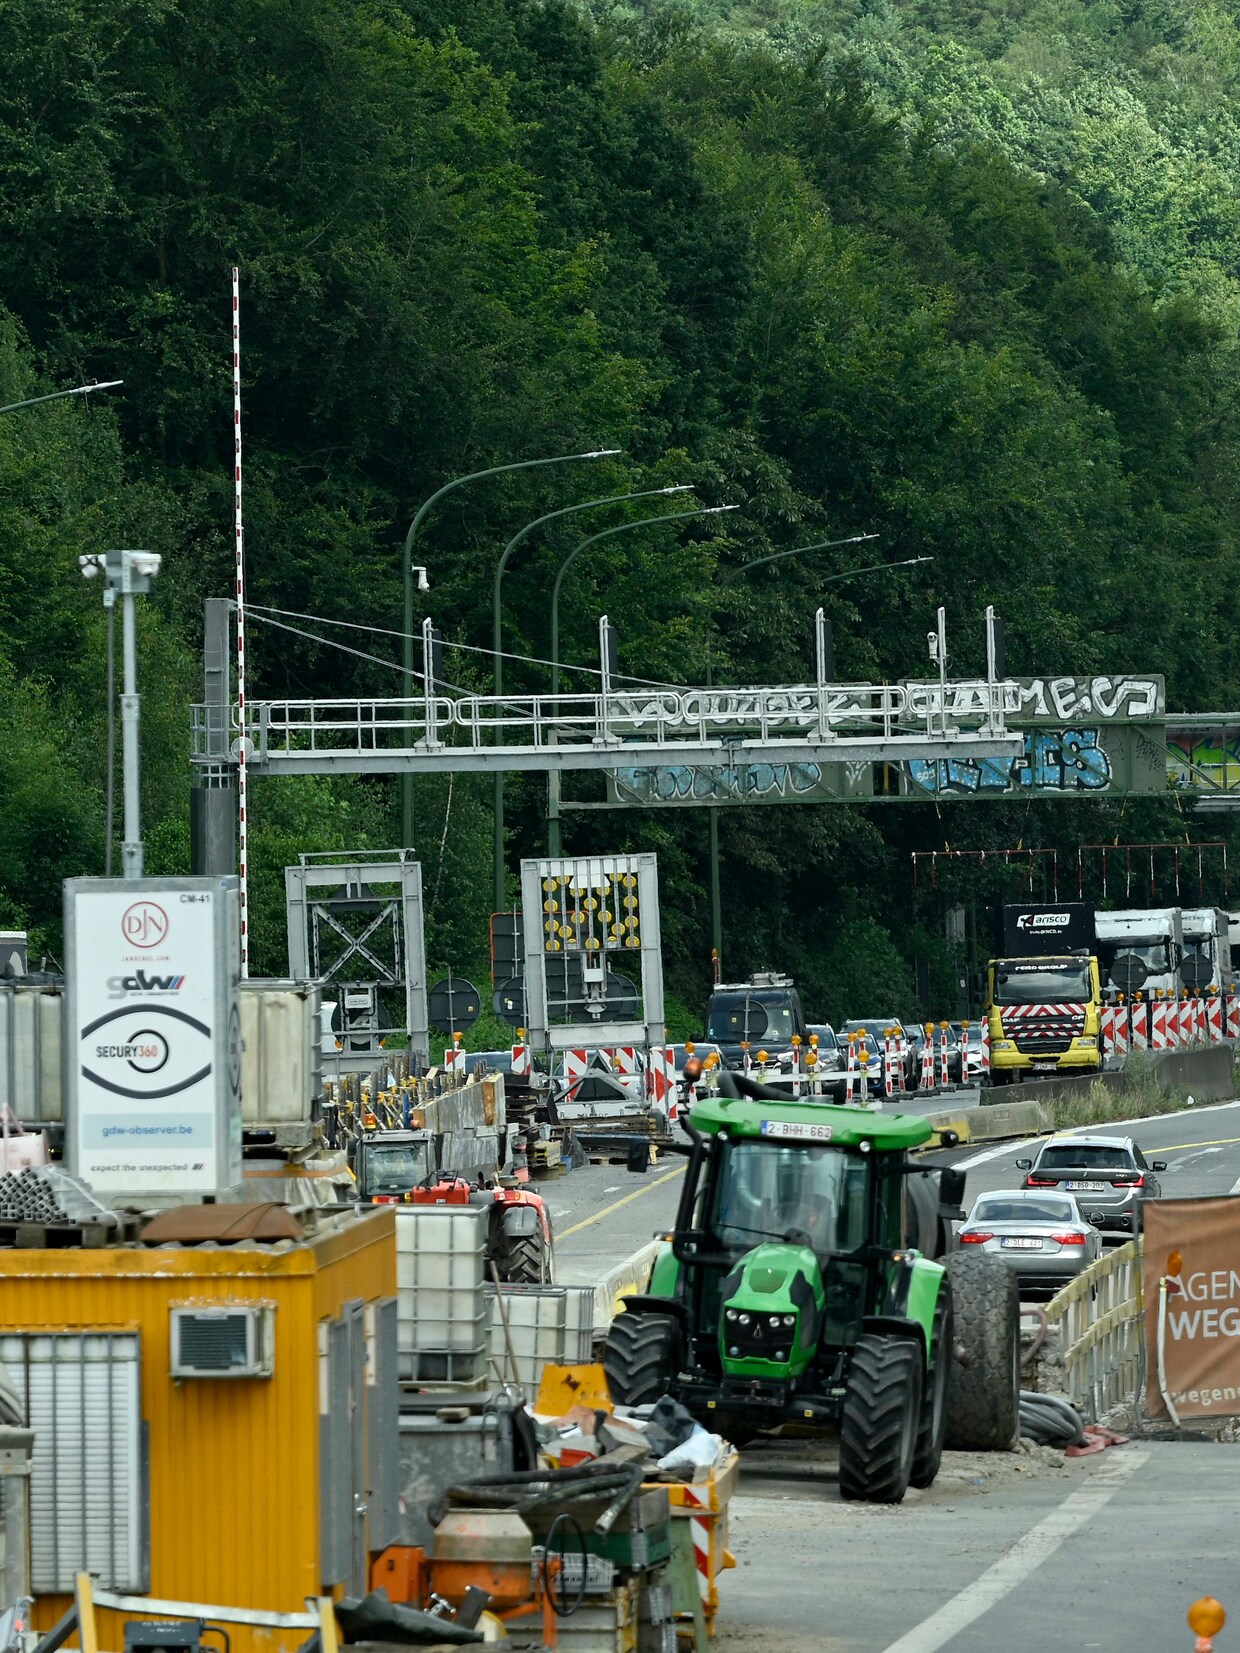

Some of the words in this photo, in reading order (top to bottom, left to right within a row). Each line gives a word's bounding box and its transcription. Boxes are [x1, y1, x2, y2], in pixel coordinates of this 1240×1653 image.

[1035, 914, 1067, 924] arisco
[96, 1045, 159, 1058] SECURY360
[102, 1125, 193, 1137] gdw-observer.be
[90, 1164, 120, 1172] expect
[122, 1163, 136, 1171] the
[139, 1163, 187, 1172] unexpected
